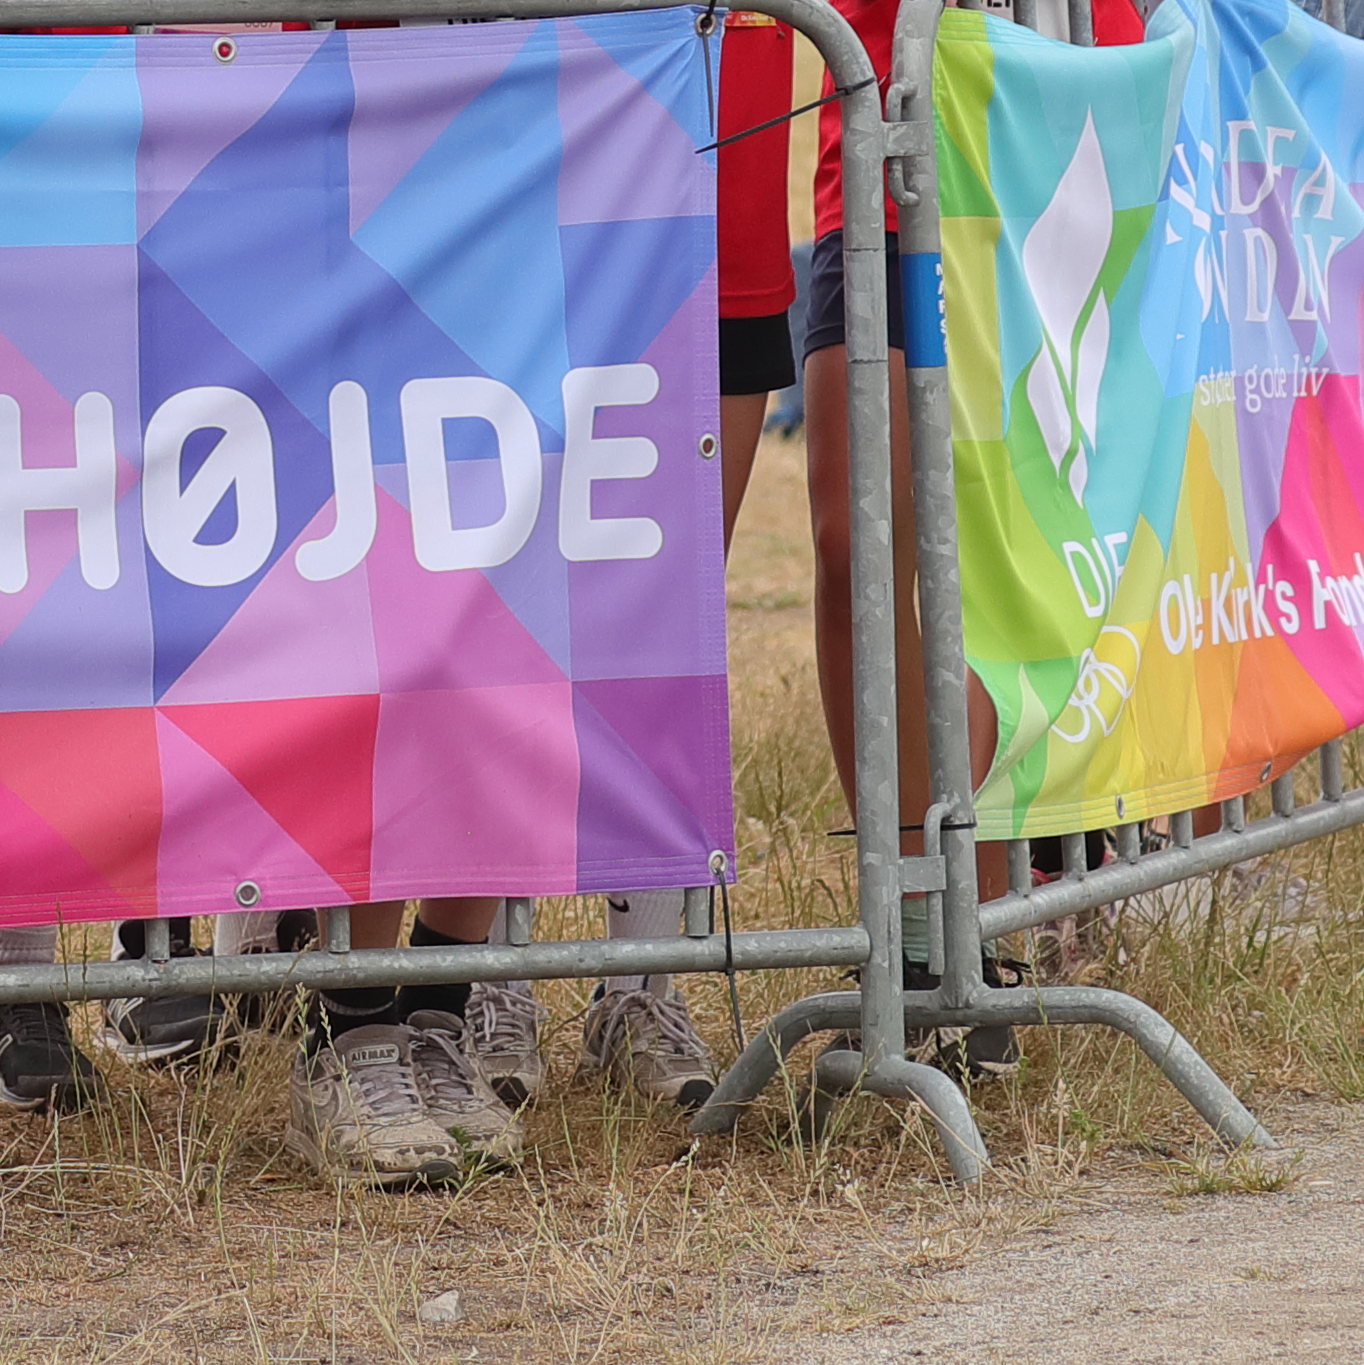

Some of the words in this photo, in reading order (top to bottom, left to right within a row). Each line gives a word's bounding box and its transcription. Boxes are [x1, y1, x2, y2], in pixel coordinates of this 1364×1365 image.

[1292, 354, 1329, 397] liv
[1159, 573, 1203, 656] Ole
[1210, 556, 1301, 646] Kirk's
